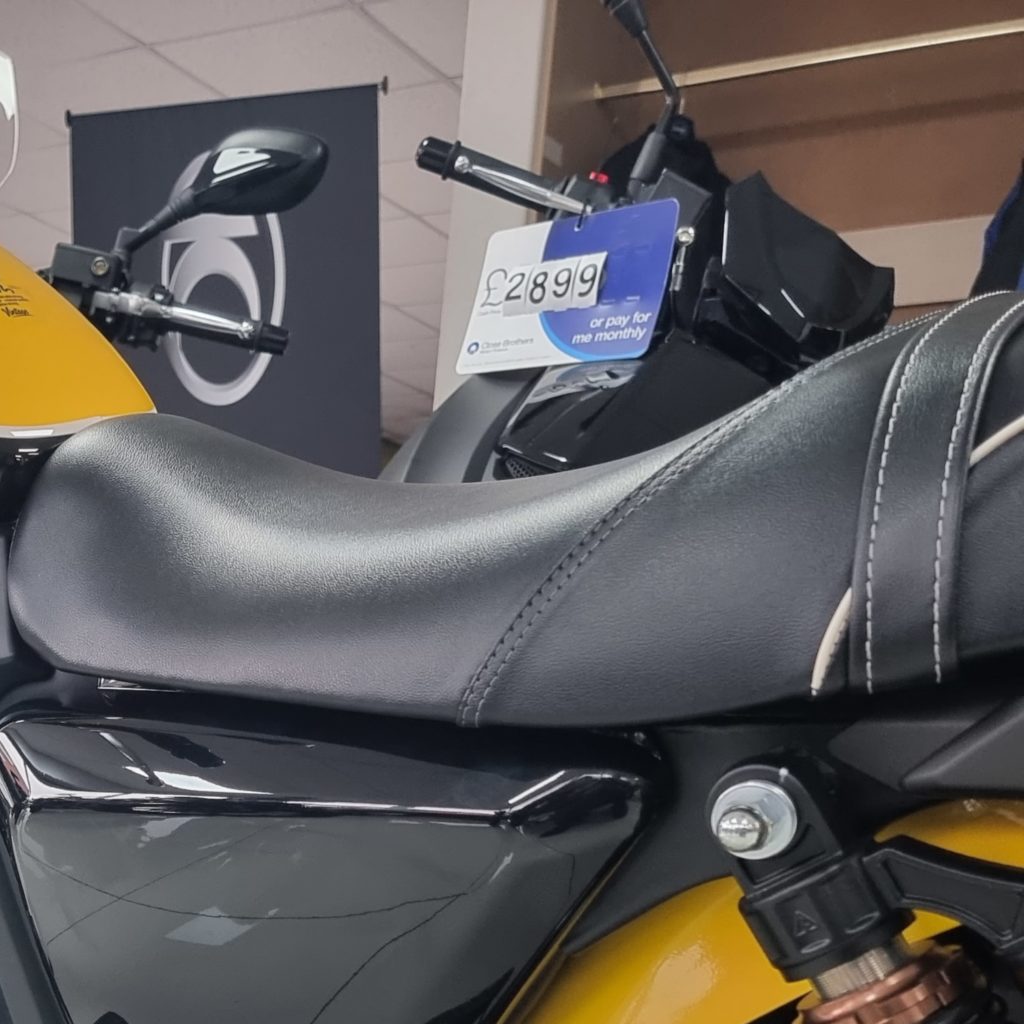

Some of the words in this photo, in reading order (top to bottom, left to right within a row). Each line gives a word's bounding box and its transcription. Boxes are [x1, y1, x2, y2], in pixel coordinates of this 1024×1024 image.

[590, 318, 604, 328] or
[605, 314, 630, 329] pay
[632, 311, 652, 324] for
[572, 333, 592, 344] me
[594, 327, 648, 342] monthly
